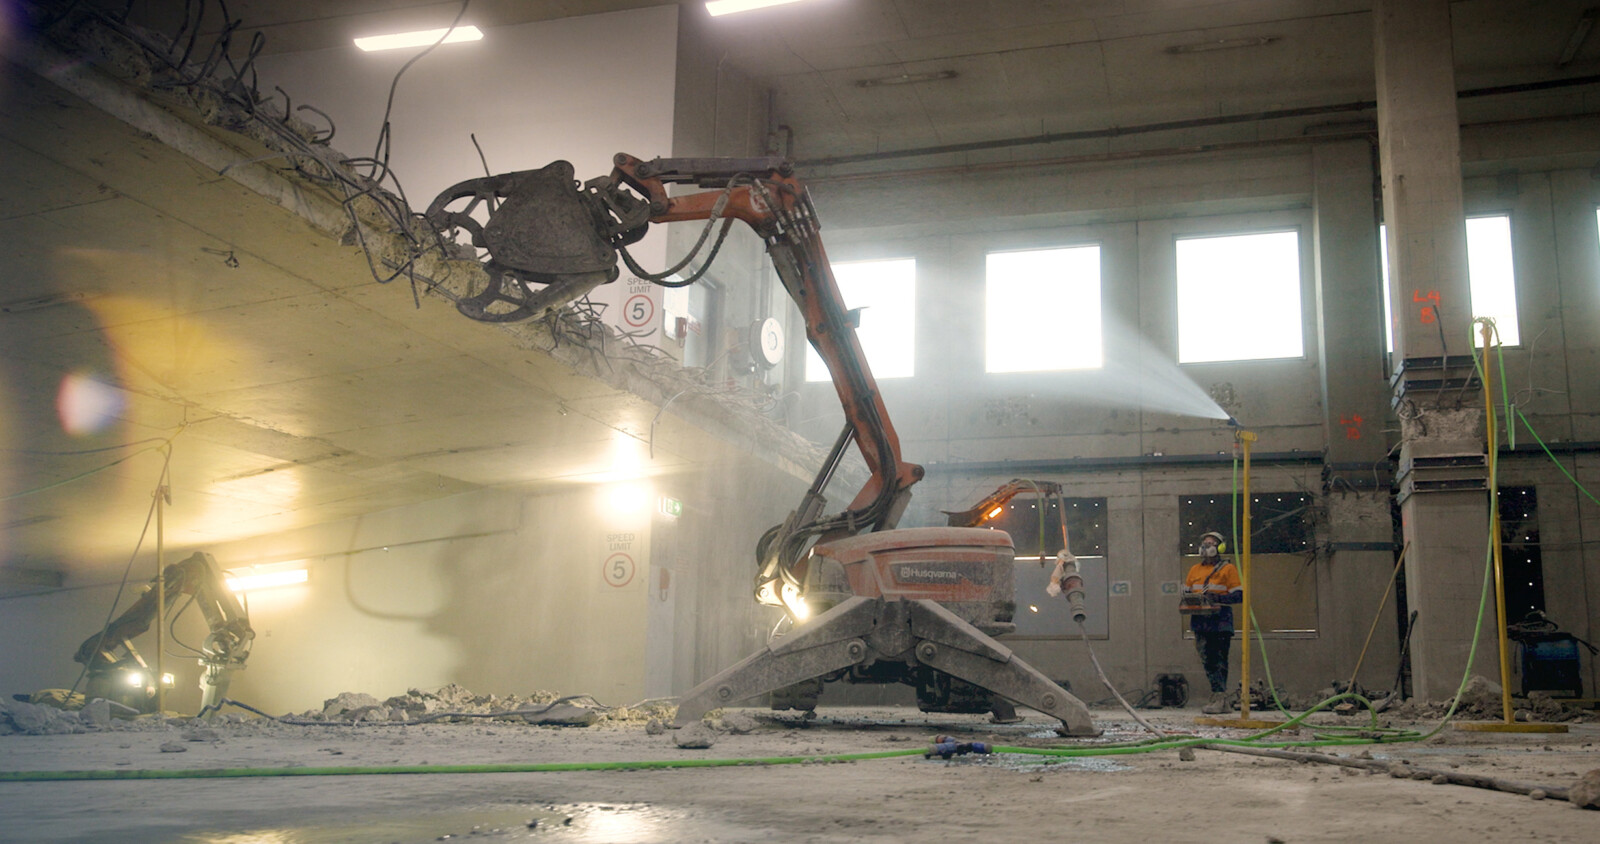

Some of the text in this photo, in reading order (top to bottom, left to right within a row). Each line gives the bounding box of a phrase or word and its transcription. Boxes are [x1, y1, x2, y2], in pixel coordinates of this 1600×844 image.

[630, 285, 651, 294] LIMIT
[1413, 289, 1440, 306] L4
[632, 303, 645, 320] 5
[607, 533, 635, 542] SPEED
[609, 542, 632, 551] LIMIT
[613, 560, 625, 579] 5
[910, 568, 957, 579] Husqvarna
